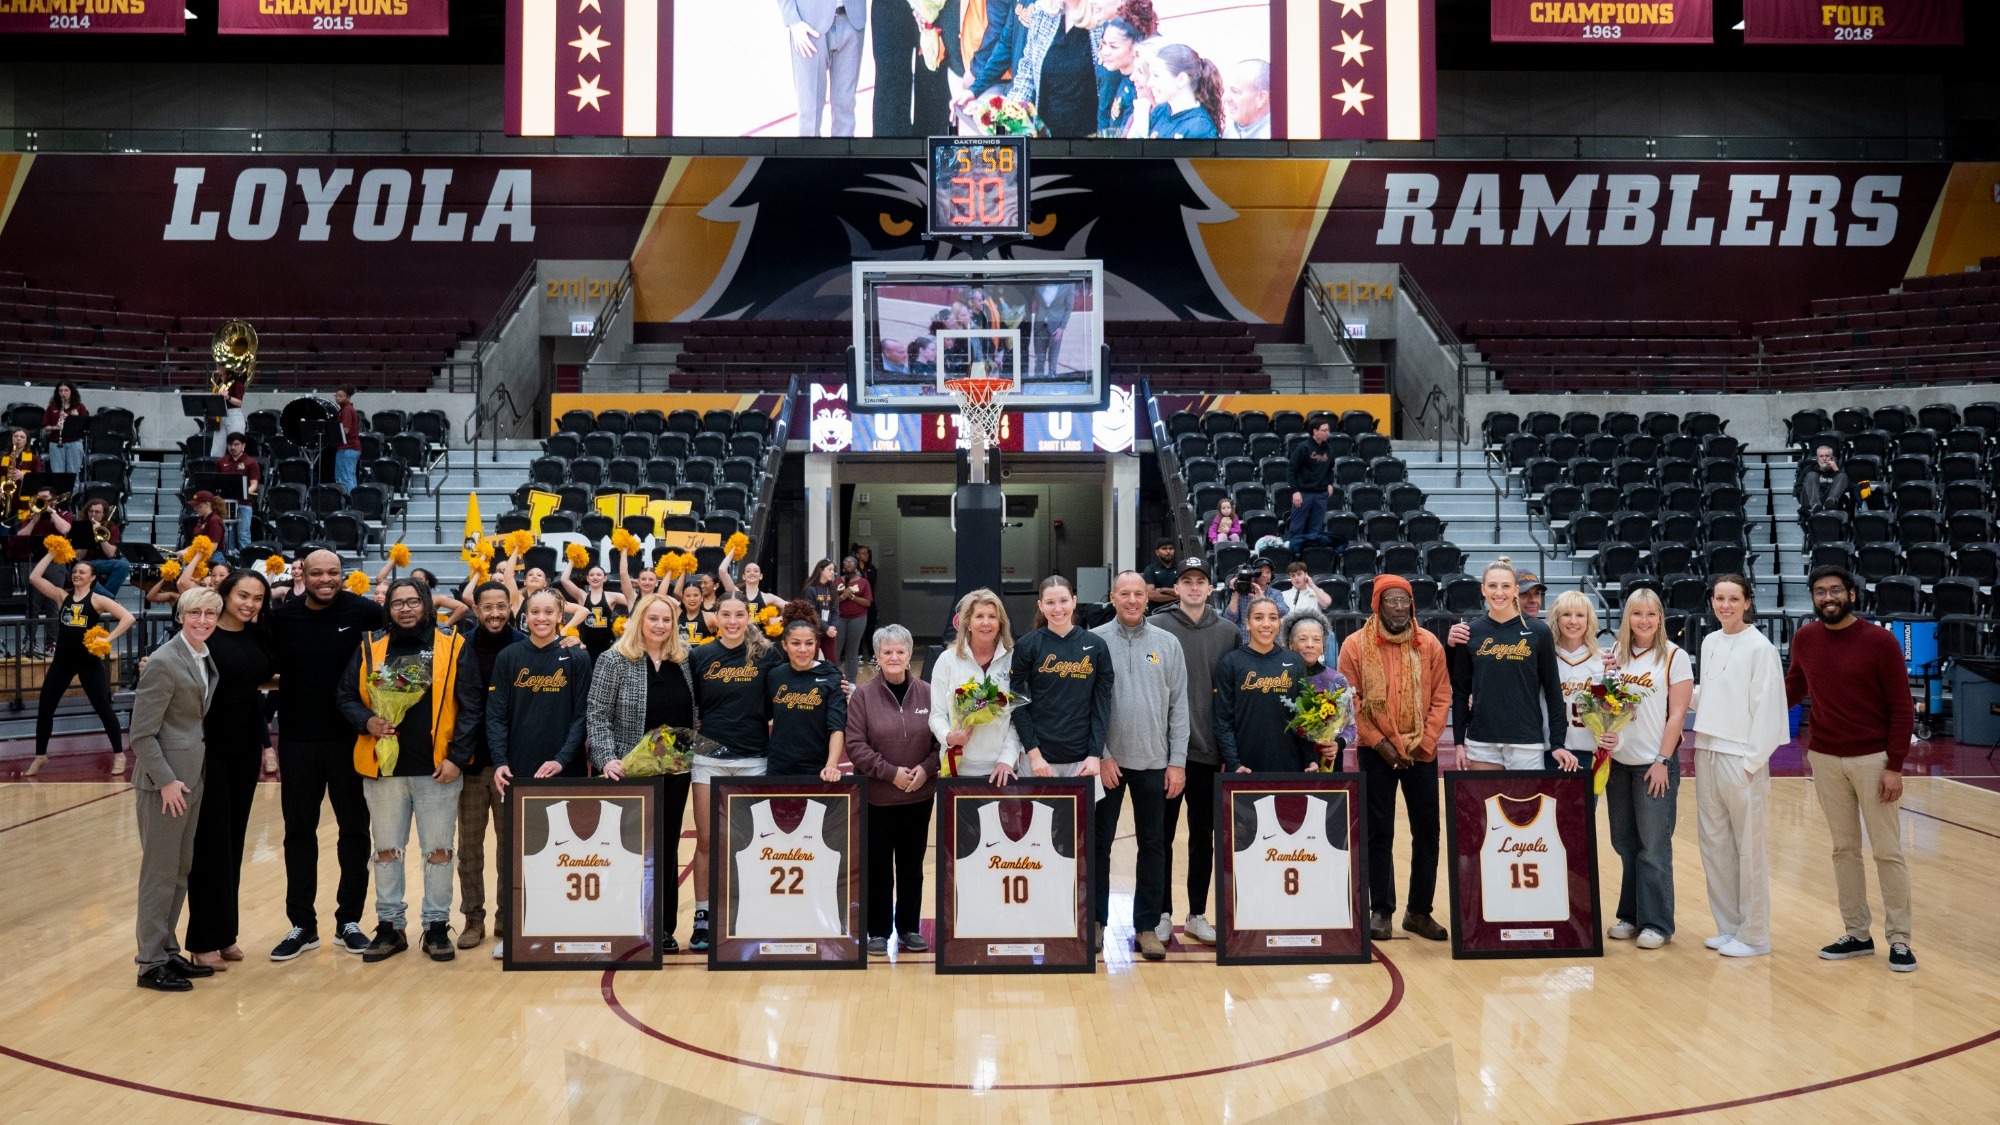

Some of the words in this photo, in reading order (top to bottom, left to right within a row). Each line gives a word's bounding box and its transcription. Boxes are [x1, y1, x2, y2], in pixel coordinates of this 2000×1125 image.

[259, 0, 408, 15] CHAMPIONS
[1530, 2, 1674, 24] CHAMPIONS
[1821, 5, 1885, 26] FOUR
[49, 15, 90, 29] 2014
[312, 16, 354, 30] 2015
[1582, 25, 1621, 39] 1963
[1834, 27, 1873, 40] 2018
[163, 167, 536, 242] LOYOLA
[951, 177, 1004, 224] 30
[1375, 172, 1903, 247] RAMBLERS
[1476, 637, 1532, 660] Loyola
[1904, 624, 1912, 661] POWERADE
[703, 660, 759, 683] Loyola
[1038, 653, 1094, 678] Loyola
[513, 667, 568, 692] Loyola
[1240, 669, 1293, 694] Loyola
[773, 684, 823, 709] Loyola
[759, 847, 815, 862] Ramblers
[1264, 848, 1318, 862] Ramblers
[1497, 836, 1549, 857] Loyola
[556, 853, 612, 868] Ramblers
[988, 855, 1043, 870] Ramblers
[566, 872, 601, 901] 30
[769, 866, 805, 895] 22
[1283, 867, 1300, 896] 8
[1510, 863, 1540, 890] 15
[1002, 875, 1029, 904] 10
